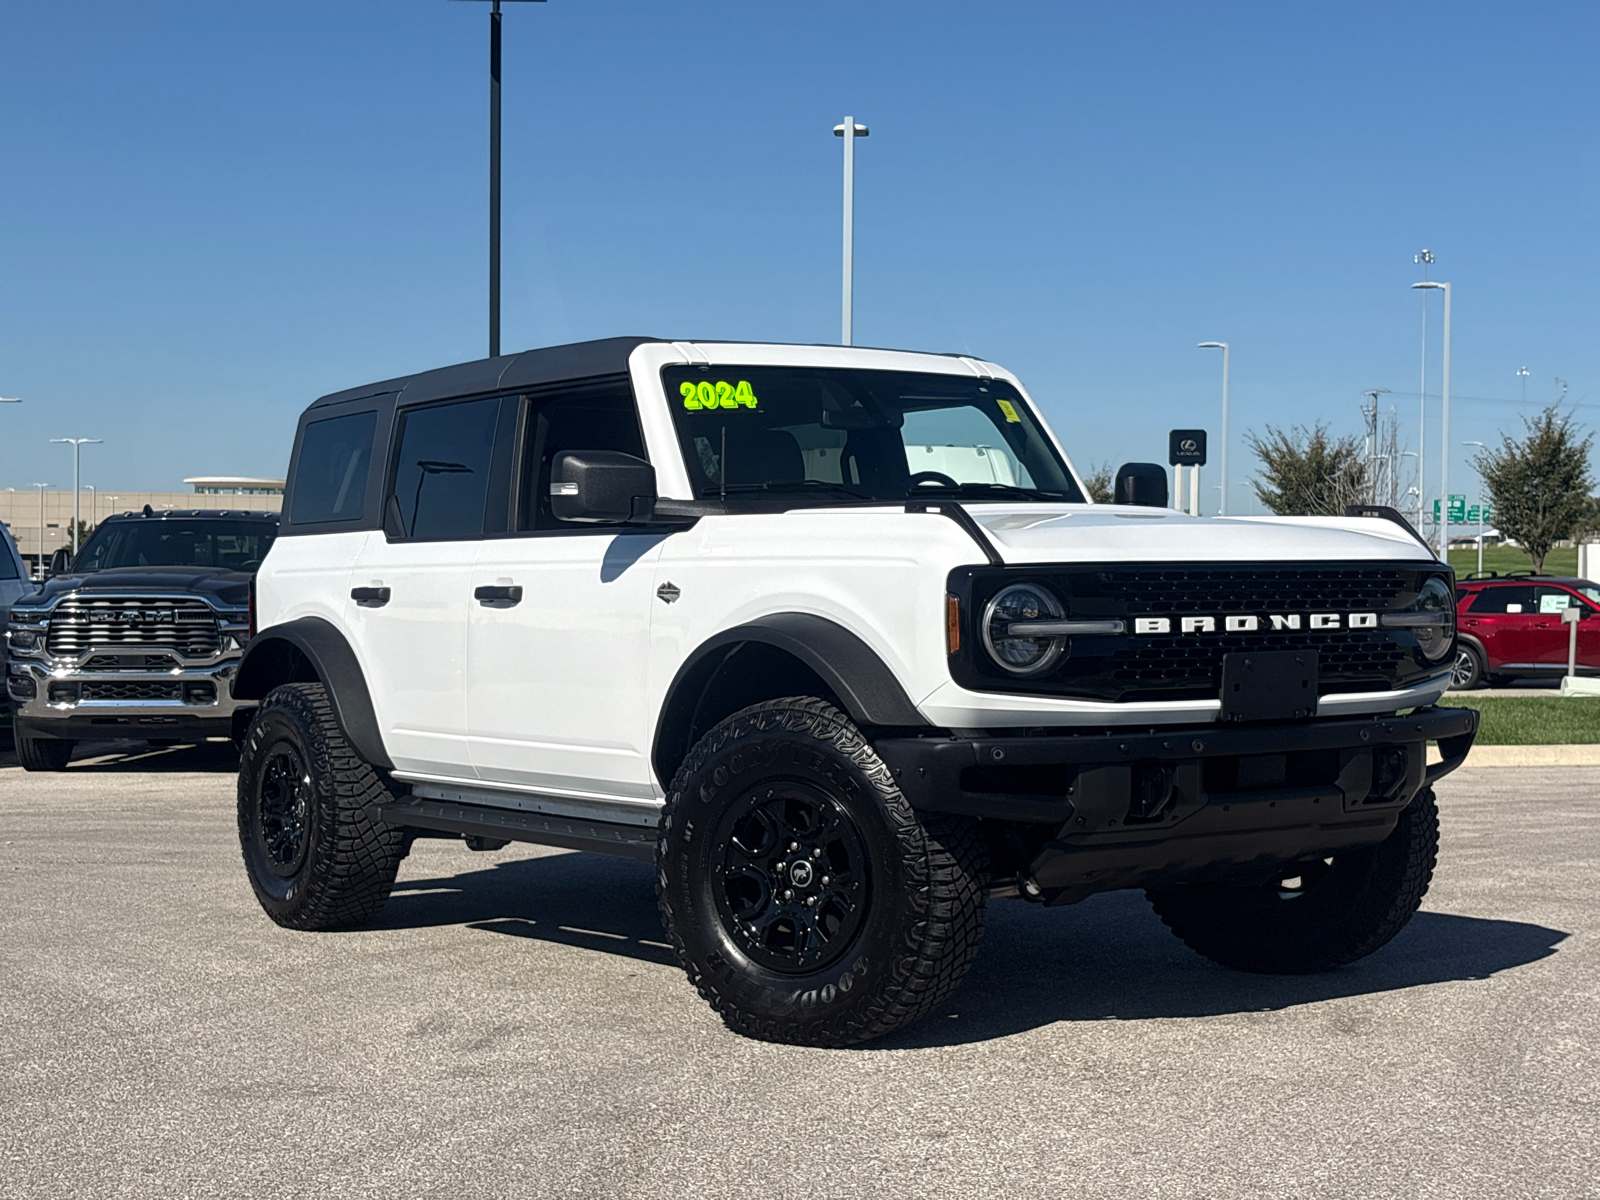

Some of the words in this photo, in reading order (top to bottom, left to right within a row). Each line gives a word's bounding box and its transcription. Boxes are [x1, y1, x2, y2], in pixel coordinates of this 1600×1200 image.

[679, 380, 758, 410] 2024
[90, 610, 172, 622] RAM
[1135, 612, 1378, 634] BRONCO
[699, 740, 860, 803] GOODYEAR
[705, 948, 868, 1016] GOODYEAR
